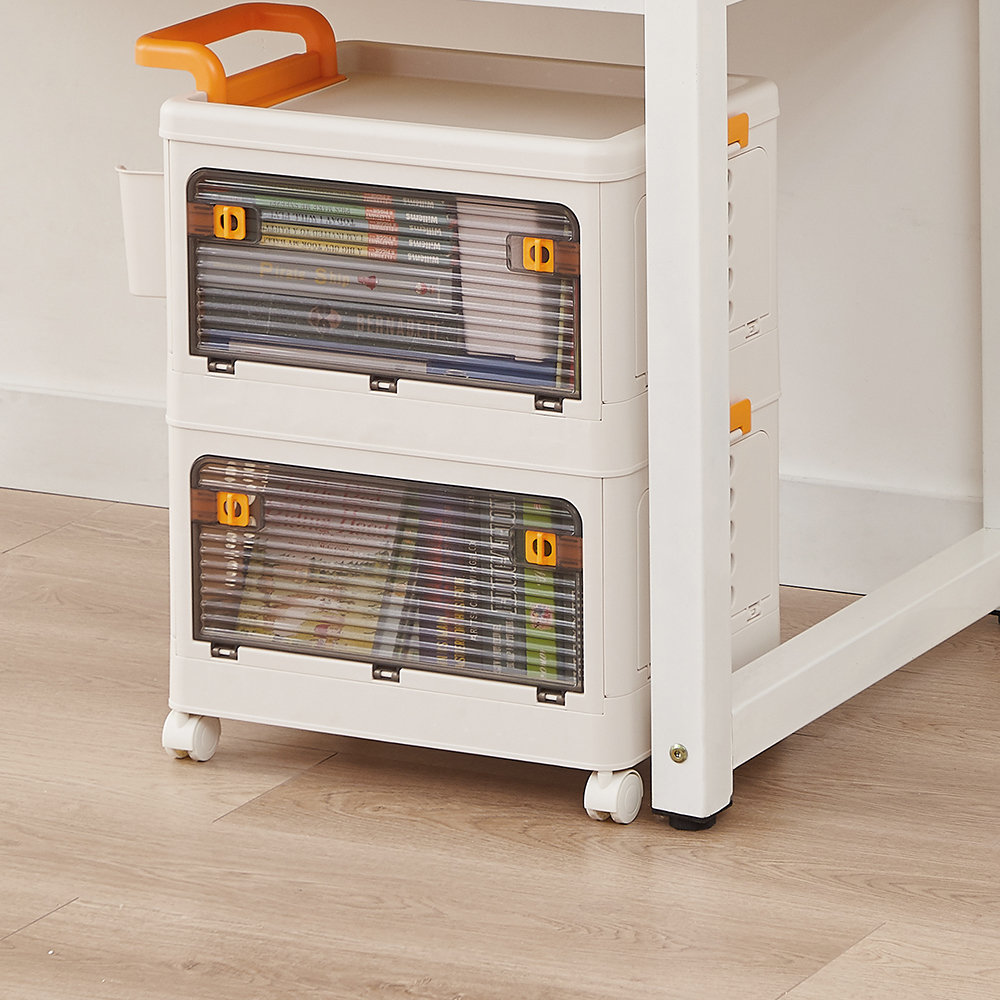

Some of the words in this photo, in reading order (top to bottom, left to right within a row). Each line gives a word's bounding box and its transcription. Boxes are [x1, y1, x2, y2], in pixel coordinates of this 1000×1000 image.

[406, 213, 438, 224] Willems
[408, 239, 441, 250] Willems
[408, 253, 440, 264] Willems
